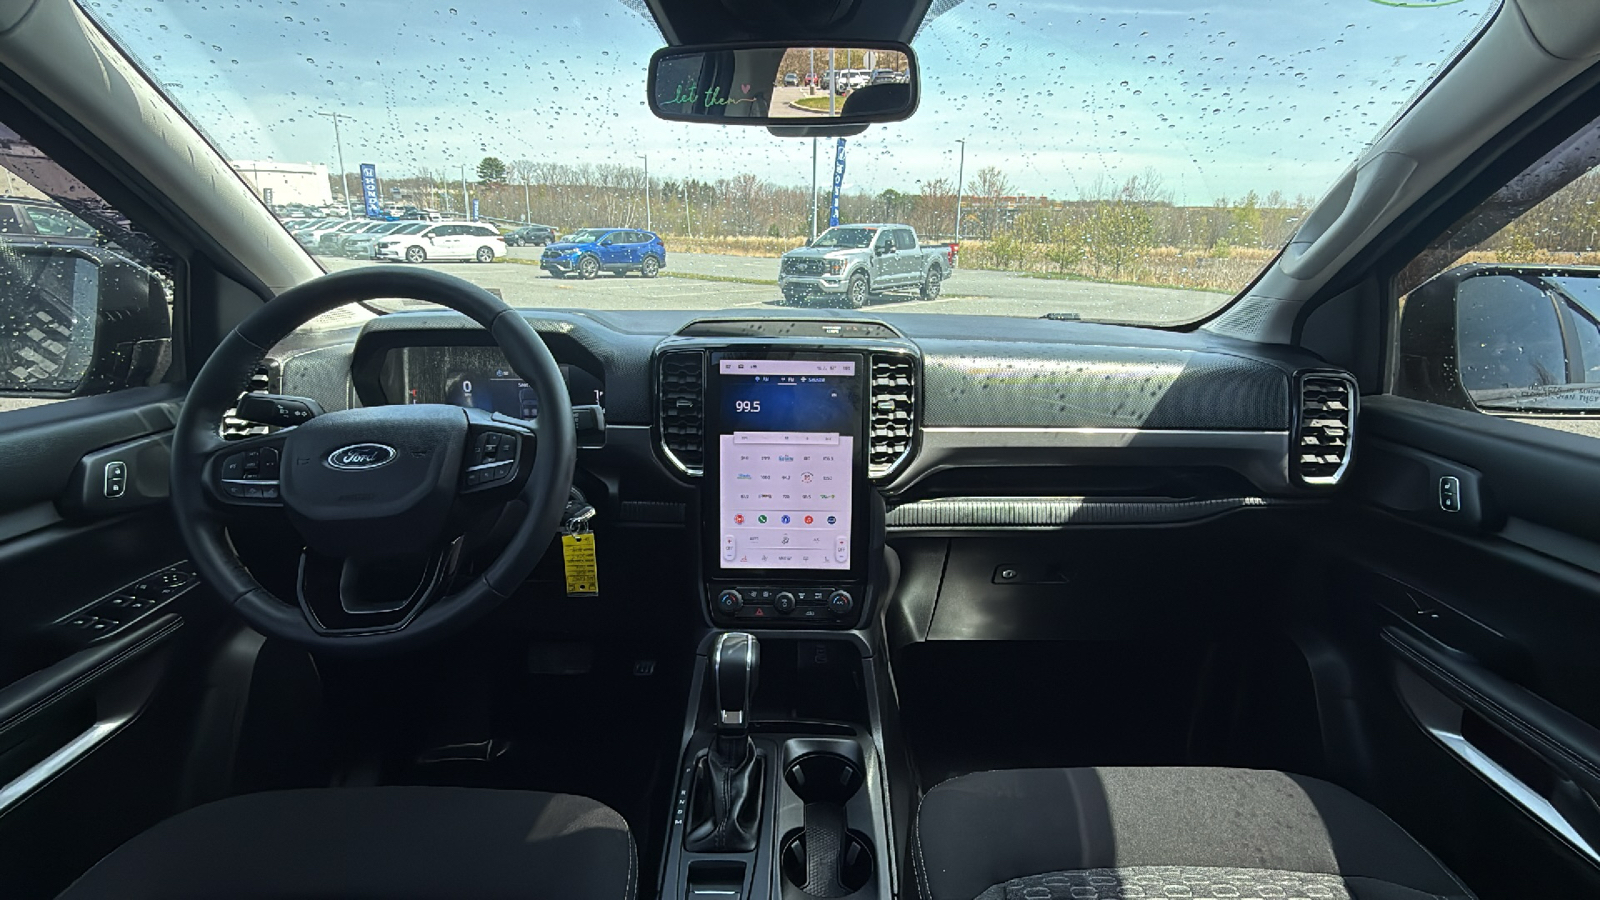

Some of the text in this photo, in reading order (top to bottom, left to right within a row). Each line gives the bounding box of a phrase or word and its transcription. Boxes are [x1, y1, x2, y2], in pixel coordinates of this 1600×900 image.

[364, 177, 379, 212] HONDA
[735, 400, 761, 413] 99.5
[343, 449, 377, 463] Ford
